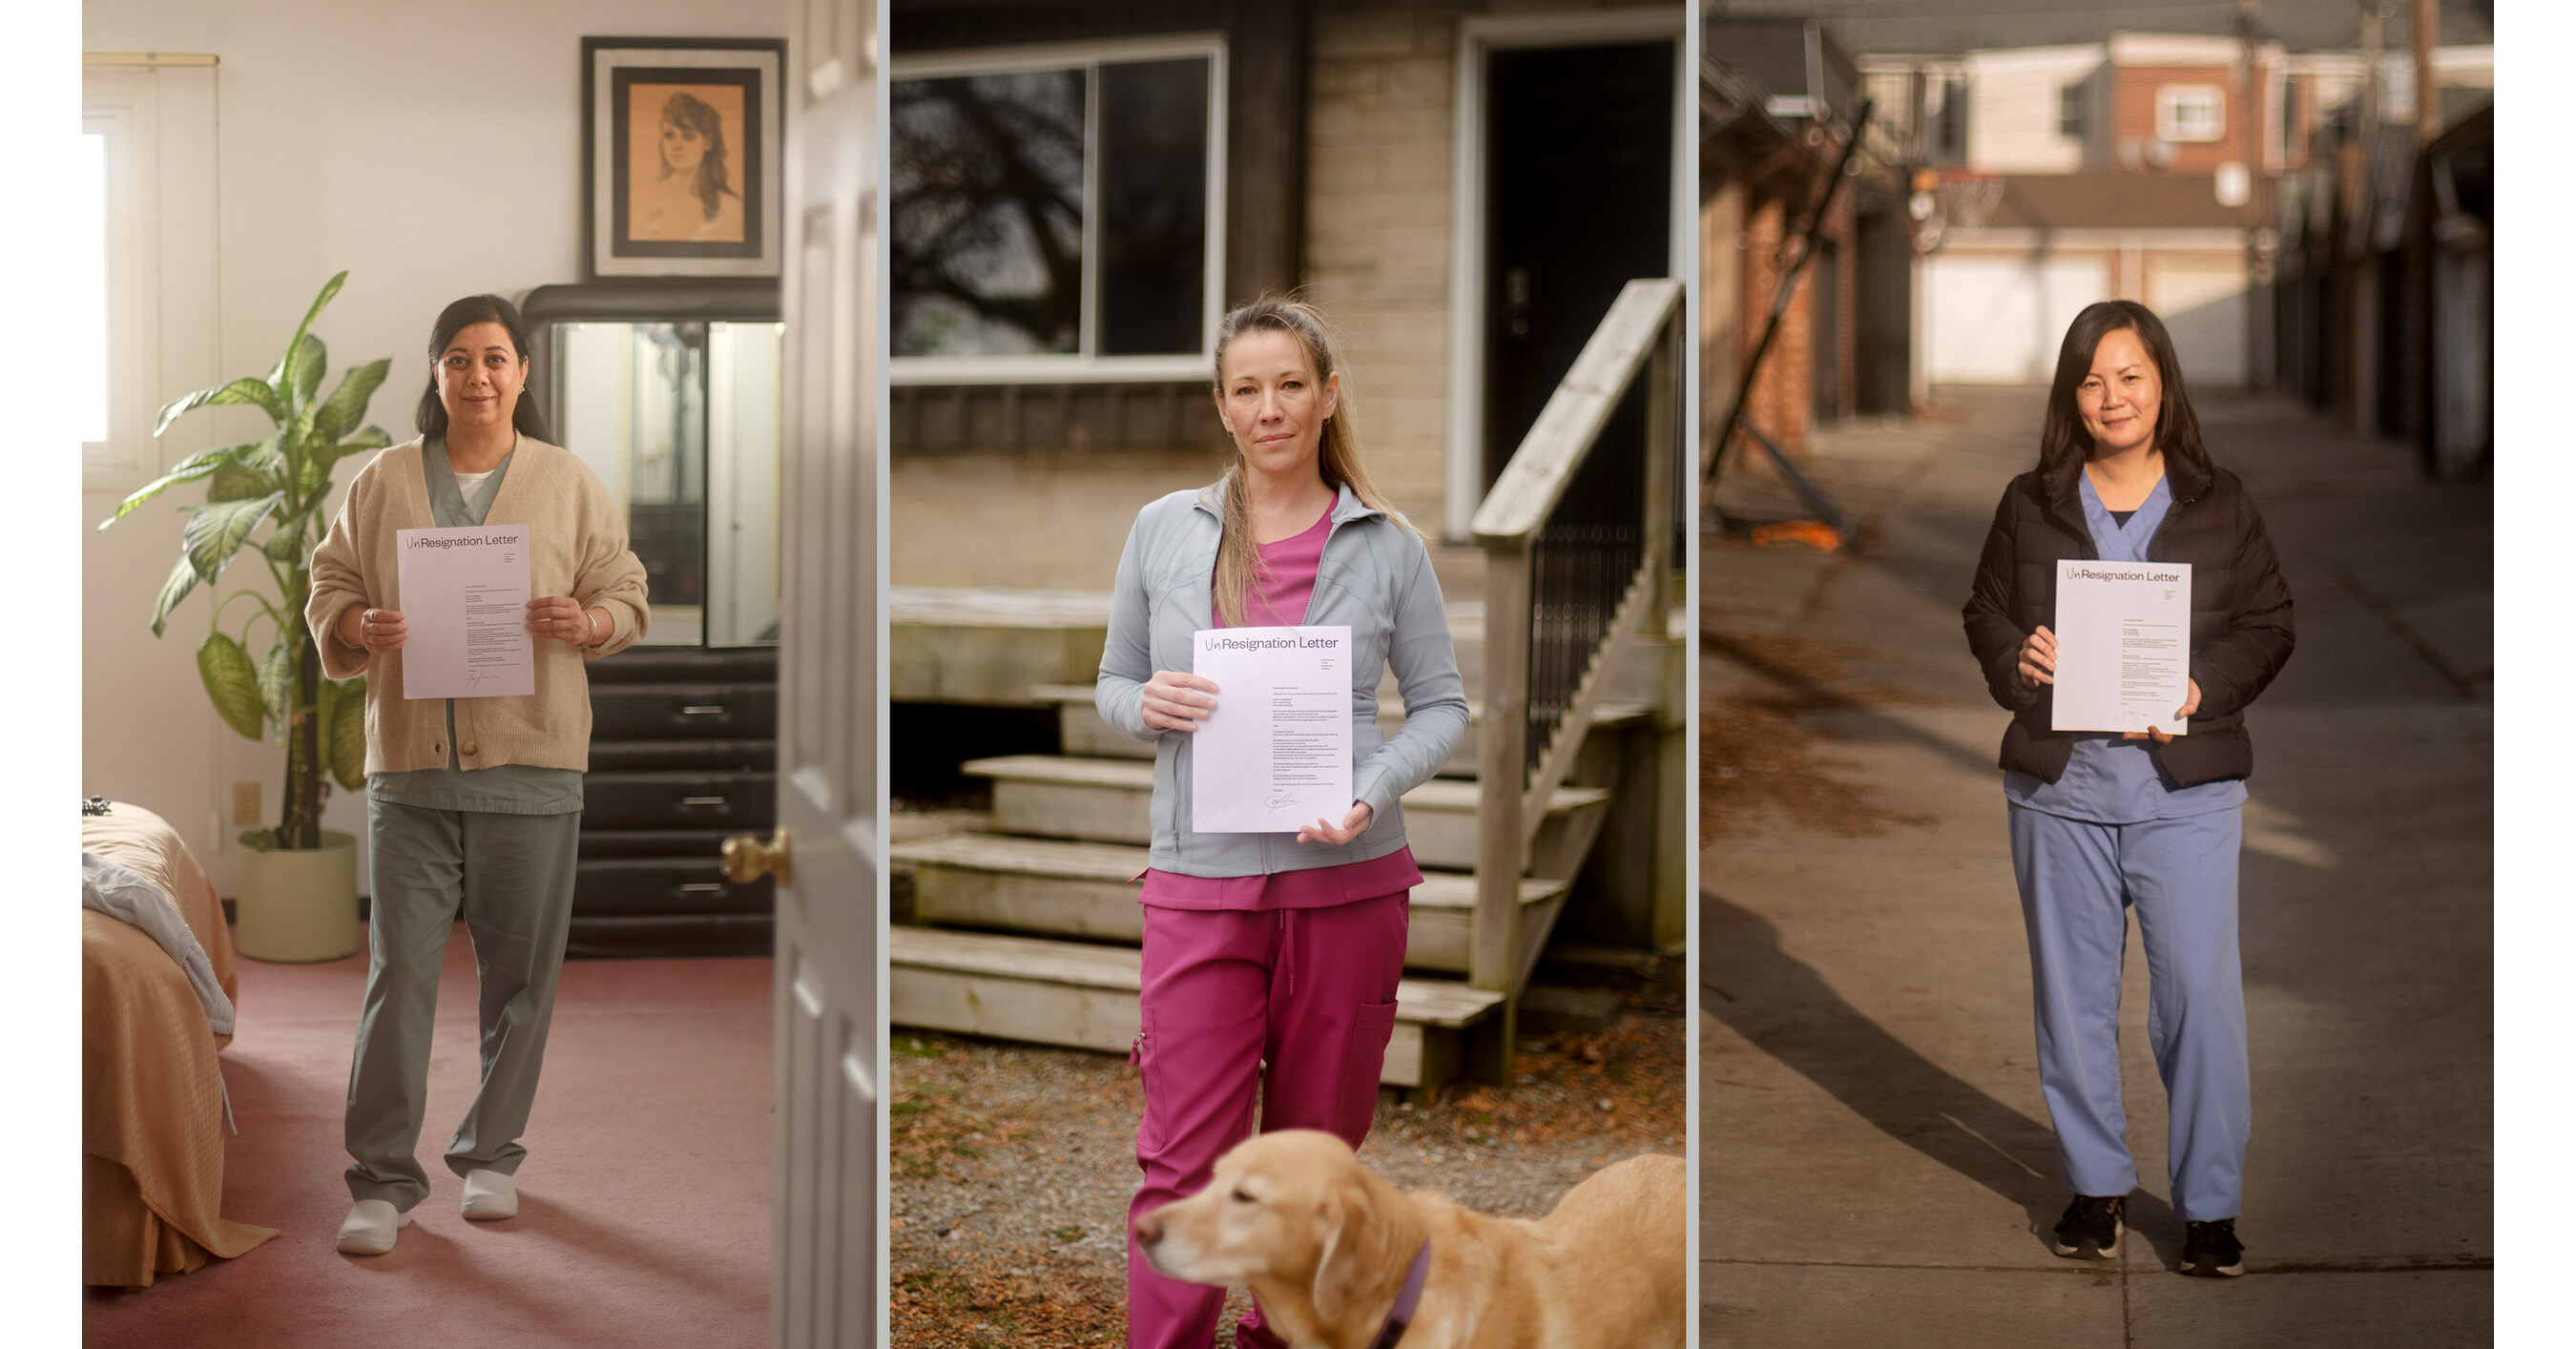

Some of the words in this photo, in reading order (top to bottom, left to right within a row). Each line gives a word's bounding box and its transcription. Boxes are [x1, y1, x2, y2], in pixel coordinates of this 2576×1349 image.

[485, 534, 518, 546] Letter
[2147, 571, 2180, 582] Letter
[1299, 636, 1339, 649] Letter
